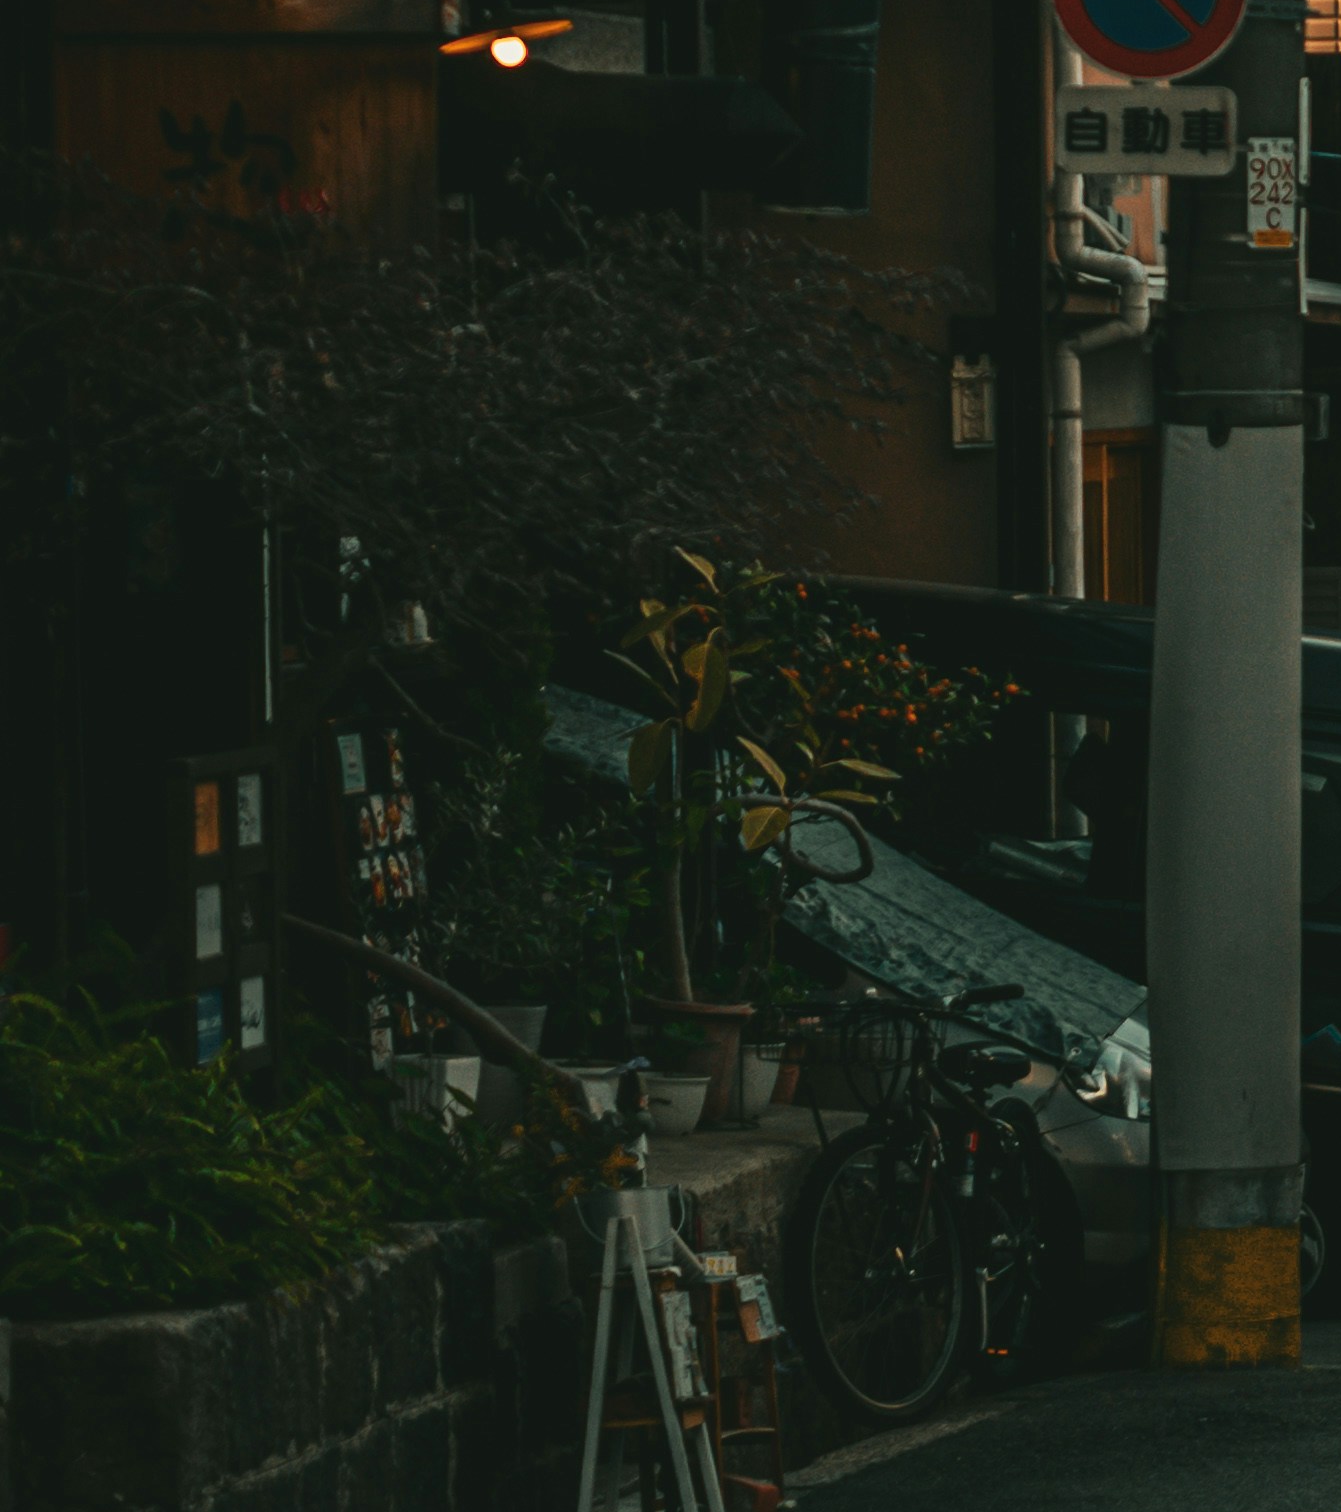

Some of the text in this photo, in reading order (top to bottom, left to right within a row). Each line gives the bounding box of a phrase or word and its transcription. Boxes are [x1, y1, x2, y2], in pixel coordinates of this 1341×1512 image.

[1064, 106, 1227, 156] 自動車
[1249, 157, 1294, 180] 90X
[1249, 181, 1294, 205] 242
